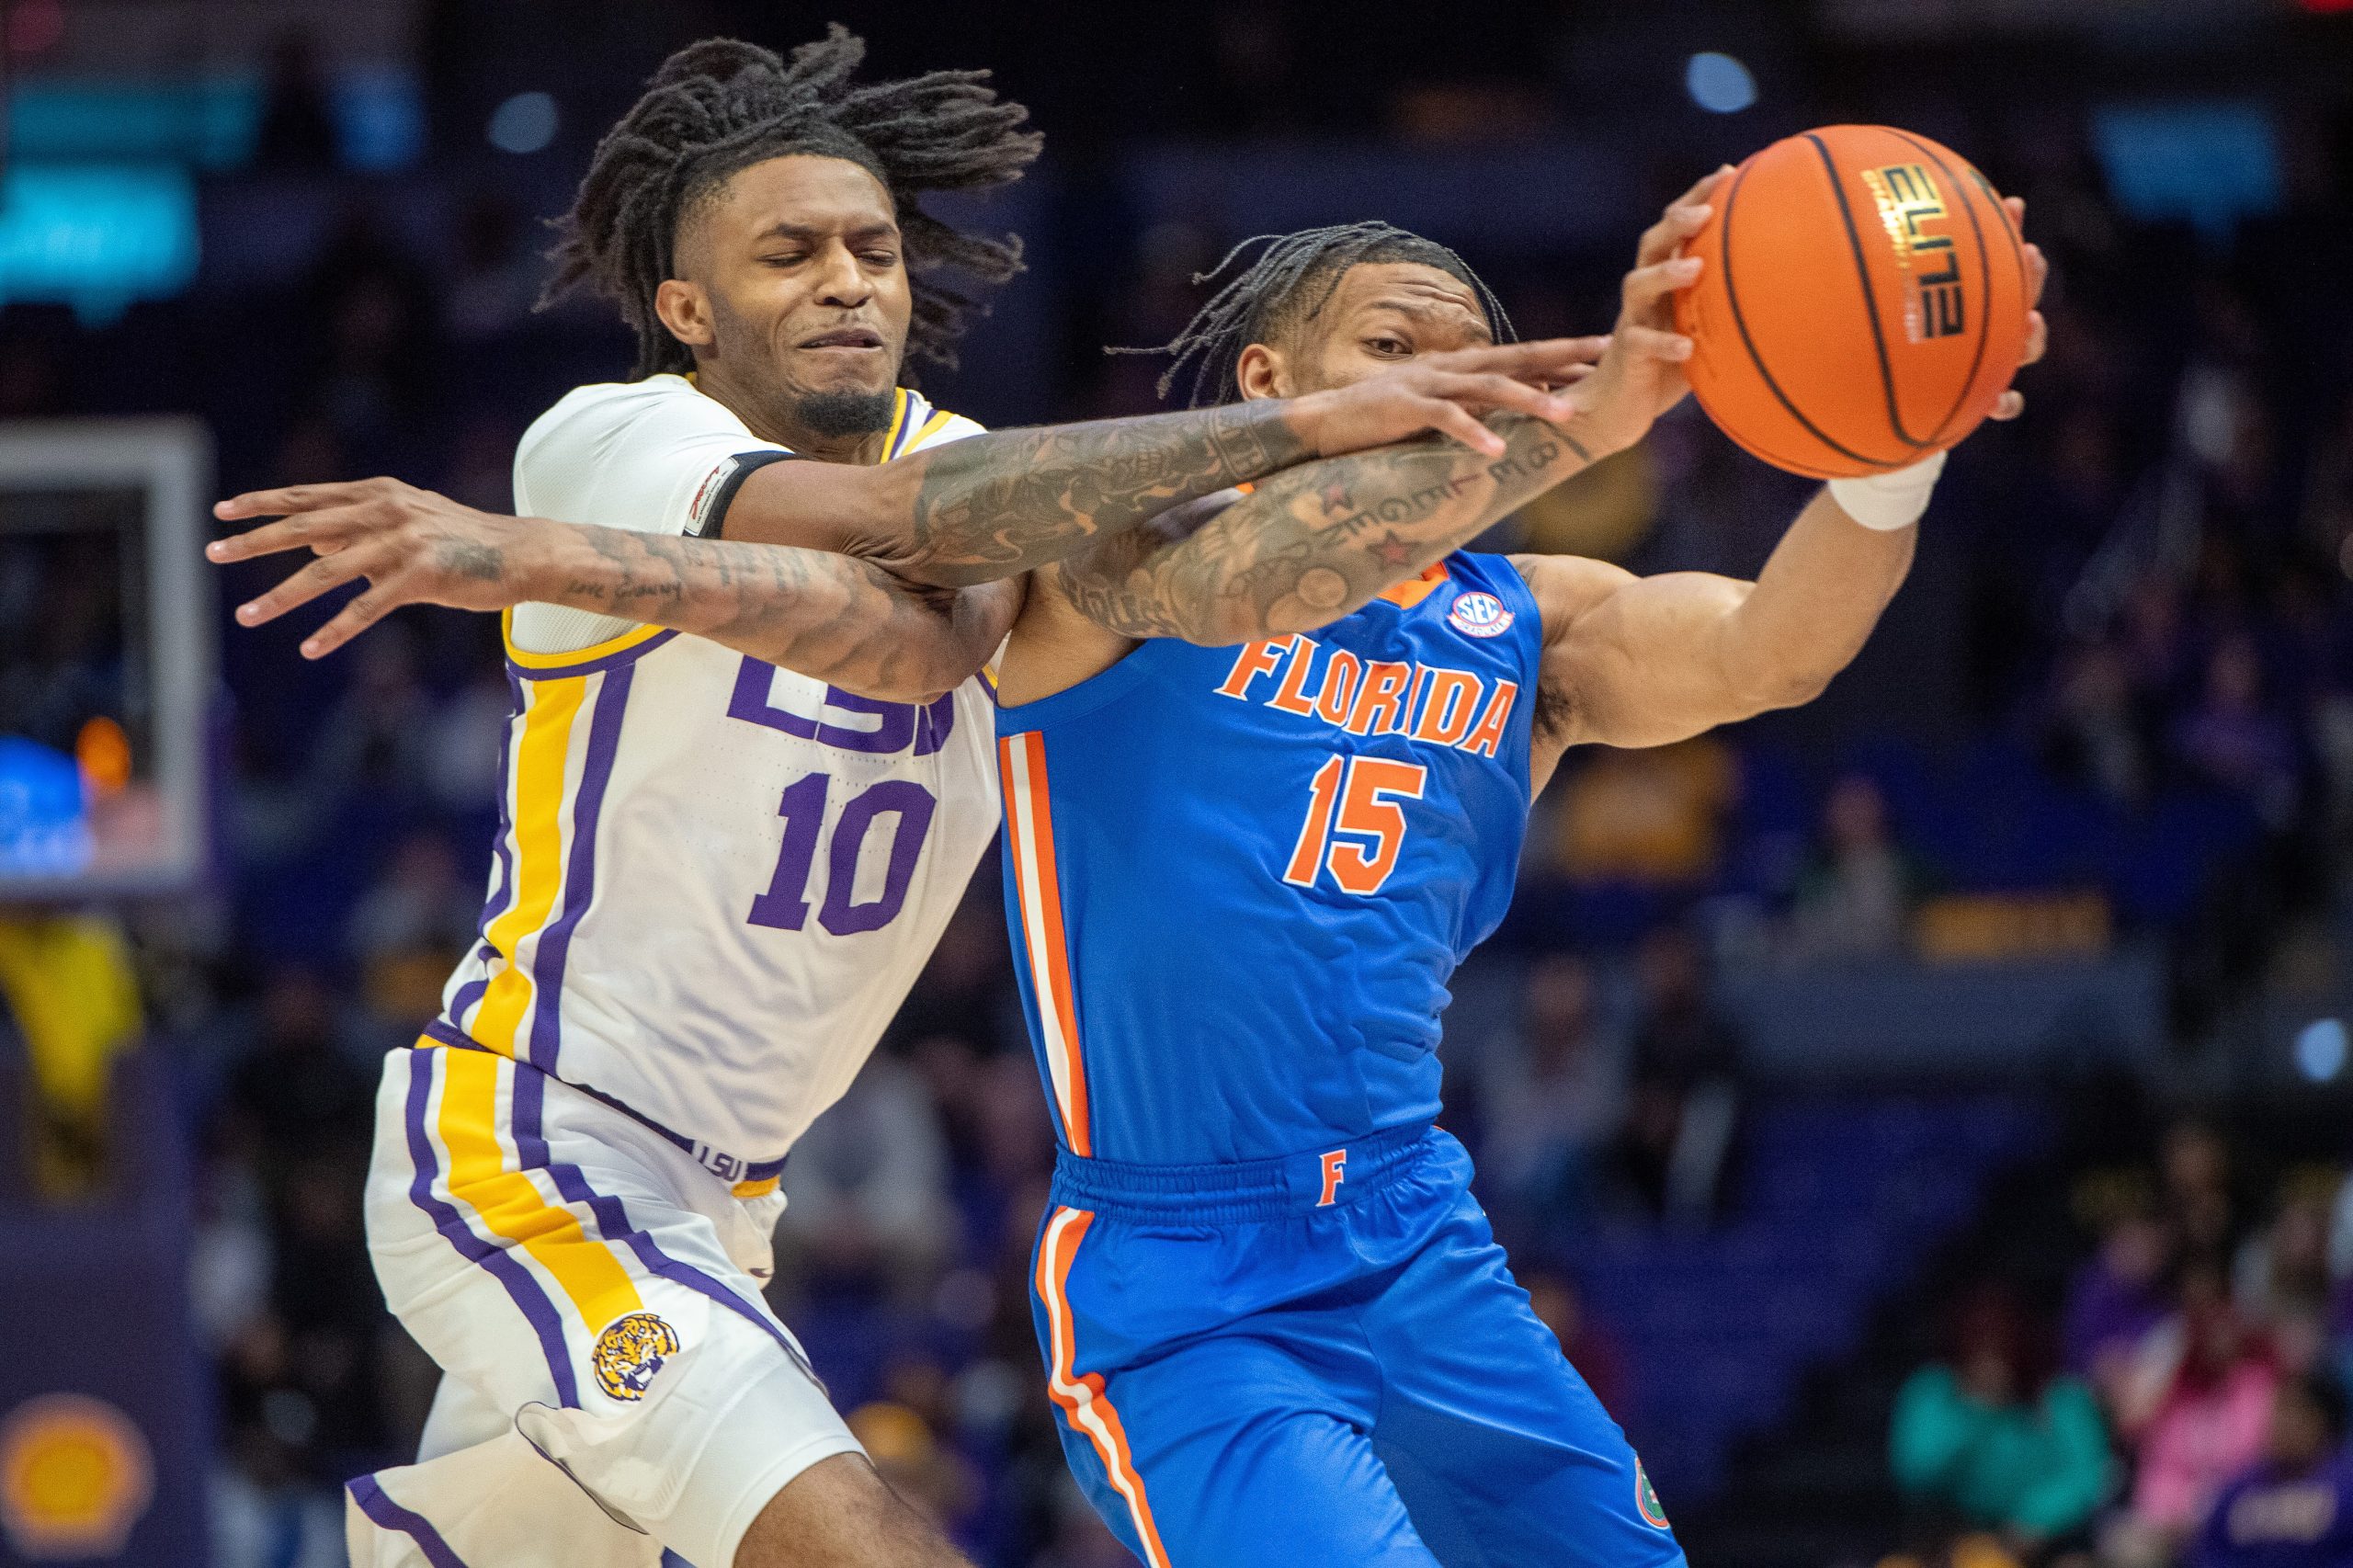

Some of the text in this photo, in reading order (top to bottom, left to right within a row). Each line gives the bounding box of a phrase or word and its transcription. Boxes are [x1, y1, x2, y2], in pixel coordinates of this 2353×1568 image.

[1882, 165, 1964, 338] ELITE
[1456, 594, 1501, 624] SEC
[1212, 633, 1518, 758] FLORIDA
[746, 771, 938, 937] 10
[1282, 753, 1428, 895] 15
[1315, 1148, 1347, 1208] F
